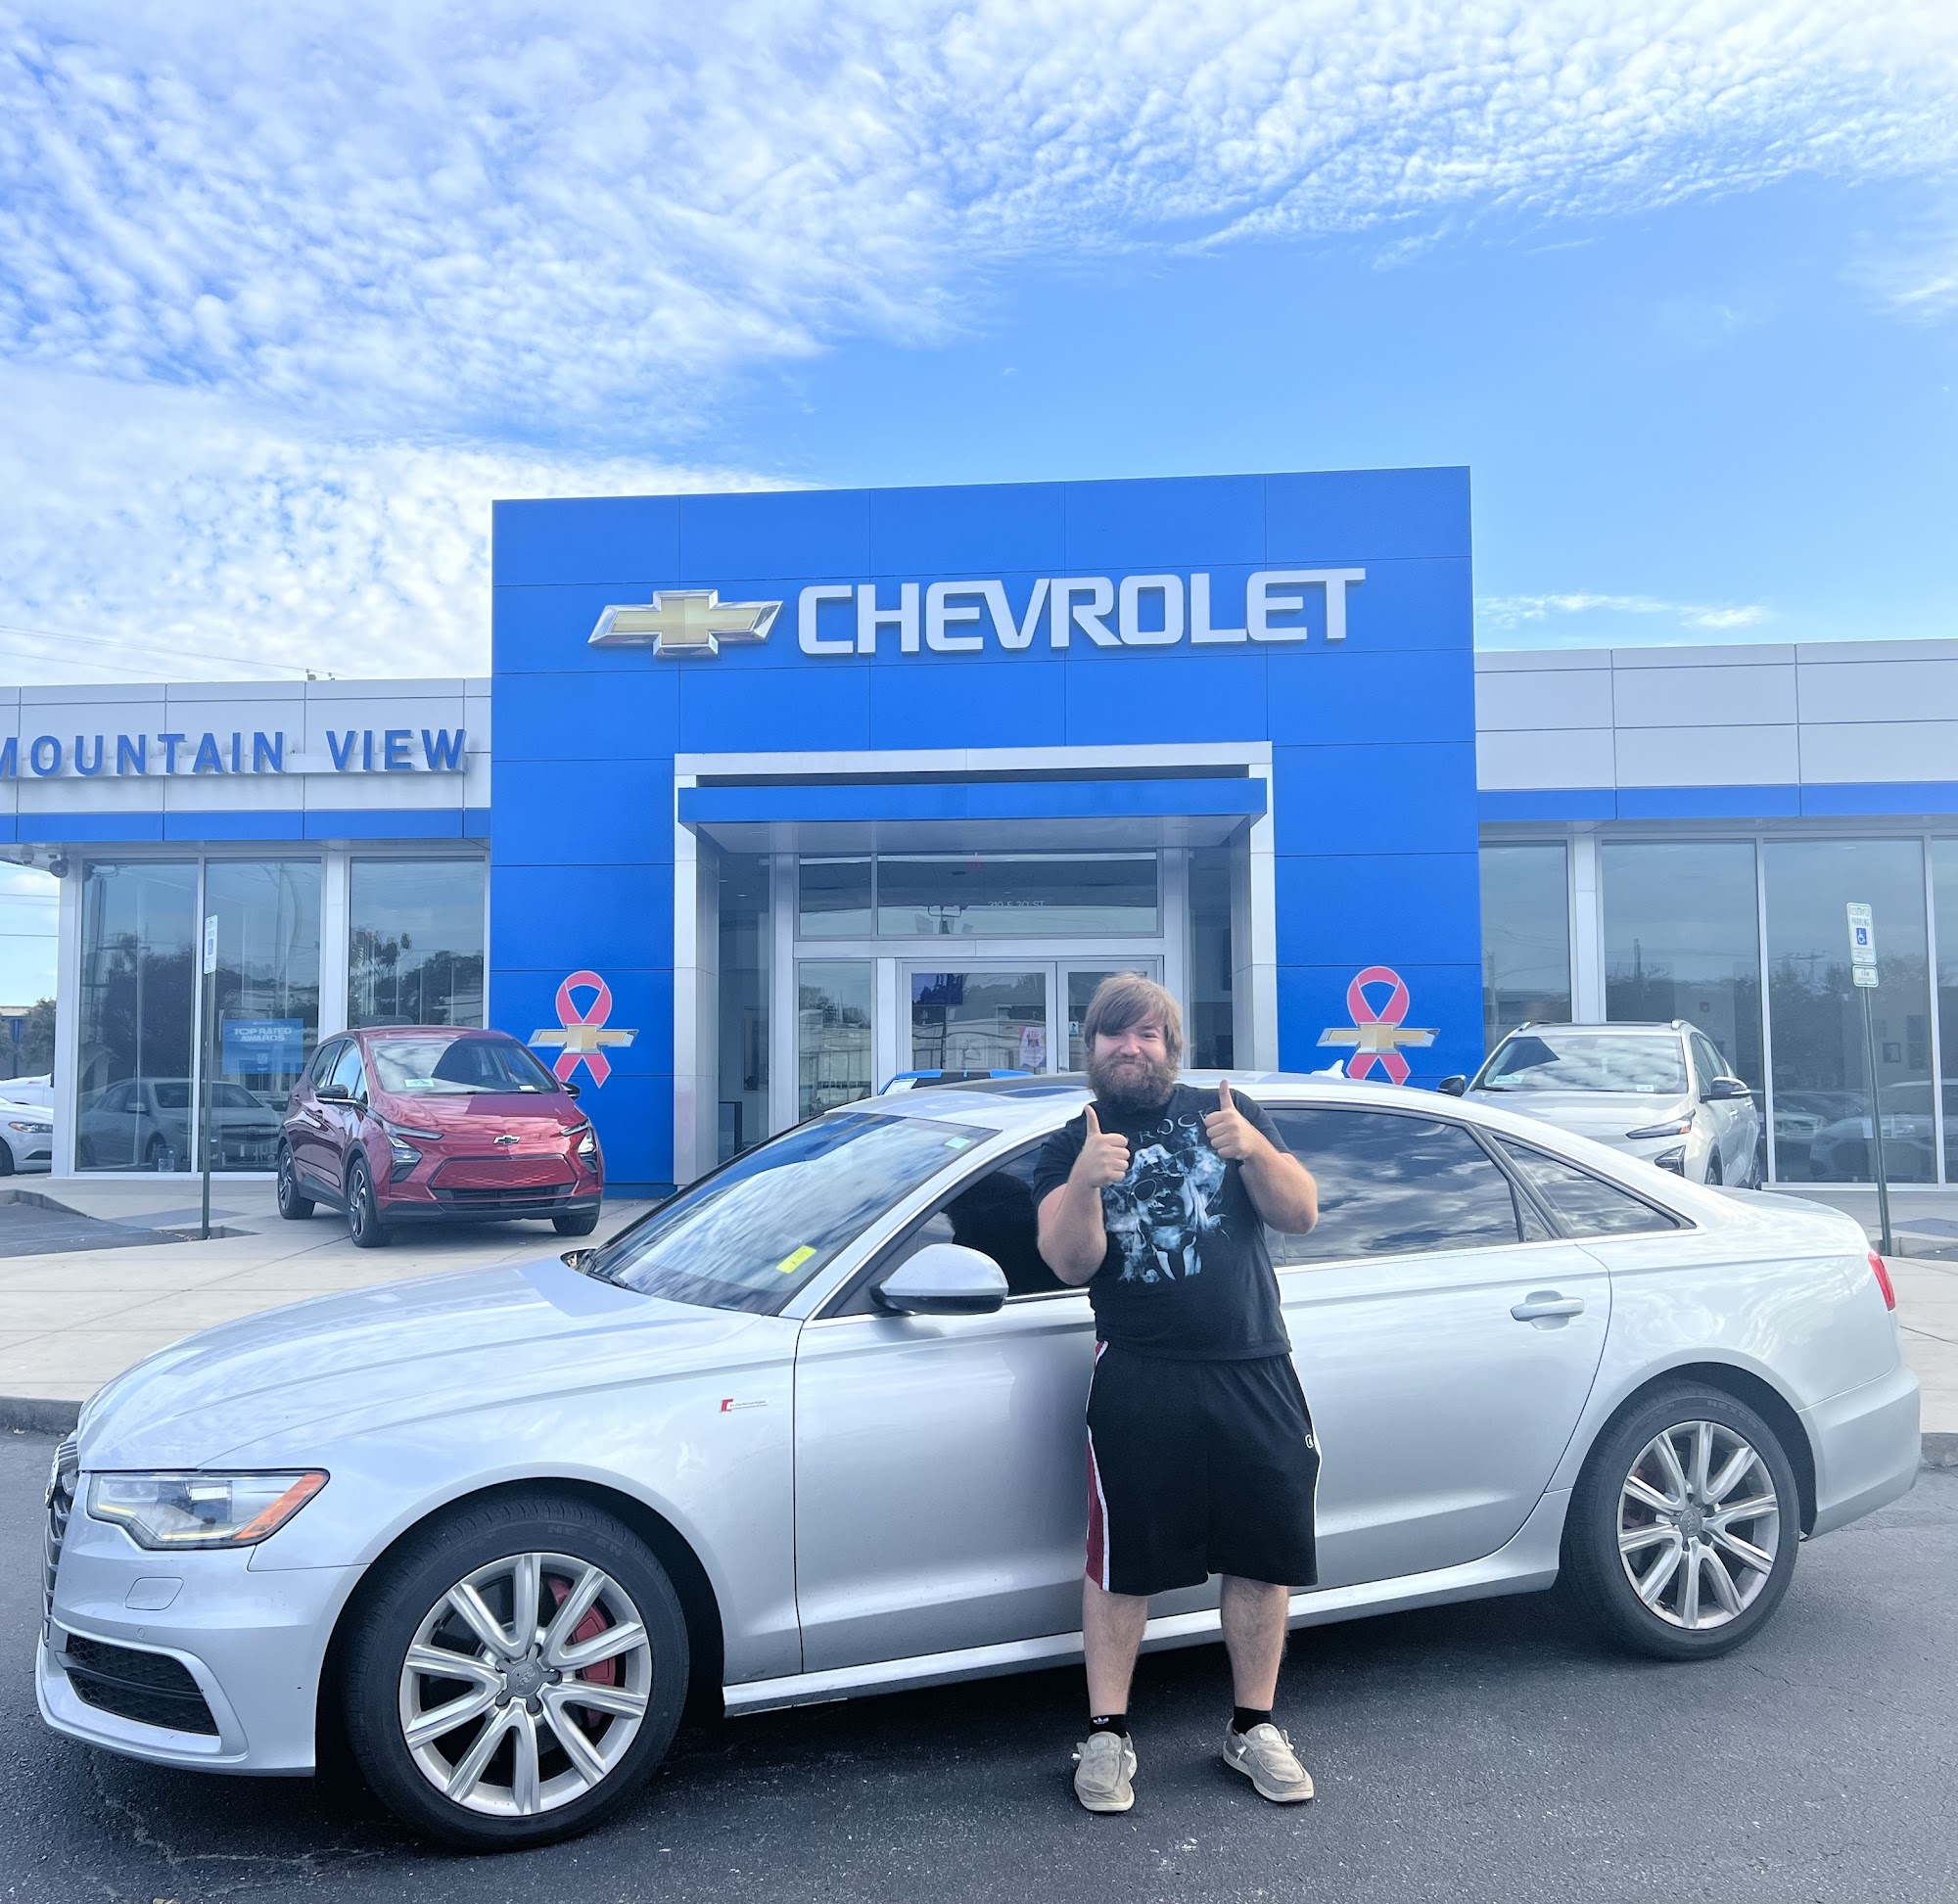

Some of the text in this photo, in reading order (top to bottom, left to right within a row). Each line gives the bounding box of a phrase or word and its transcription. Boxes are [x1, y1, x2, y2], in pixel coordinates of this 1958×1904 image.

[798, 567, 1367, 655] CHEVROLET
[325, 728, 467, 773] VIEW
[240, 1034, 286, 1043] AWARDS
